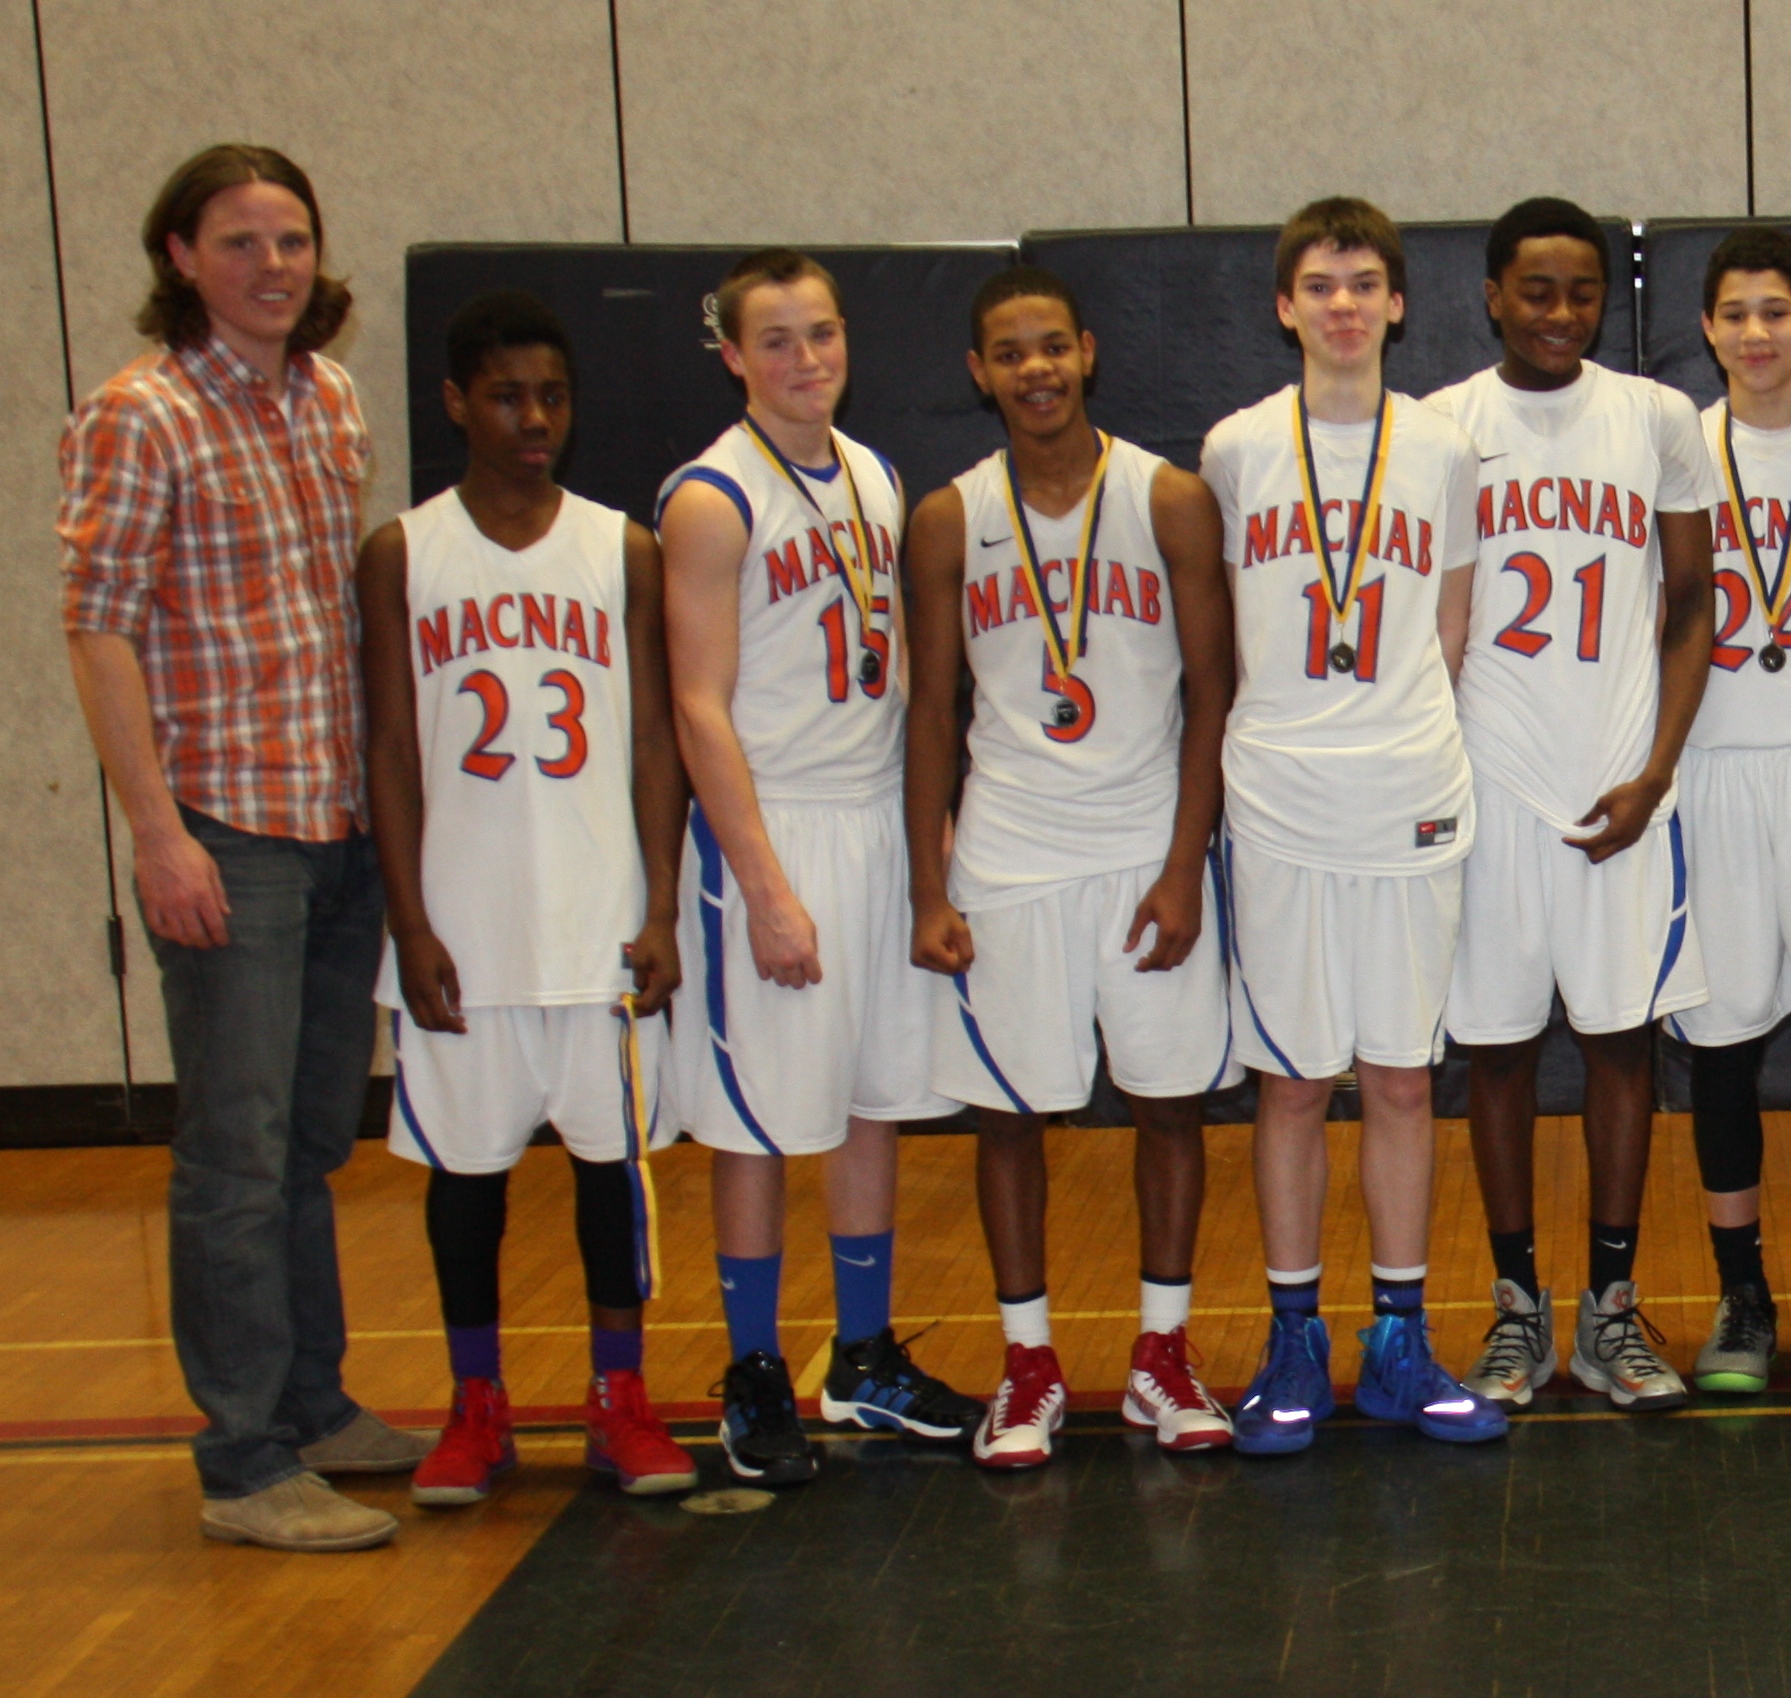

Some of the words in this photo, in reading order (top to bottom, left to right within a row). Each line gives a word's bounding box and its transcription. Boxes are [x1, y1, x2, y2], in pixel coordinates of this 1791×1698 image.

[417, 593, 611, 677] MACNAB
[818, 594, 890, 703] 15
[1302, 573, 1386, 683] 11
[1492, 551, 1606, 662] 21
[456, 667, 588, 782] 23
[1041, 637, 1095, 743] 5
